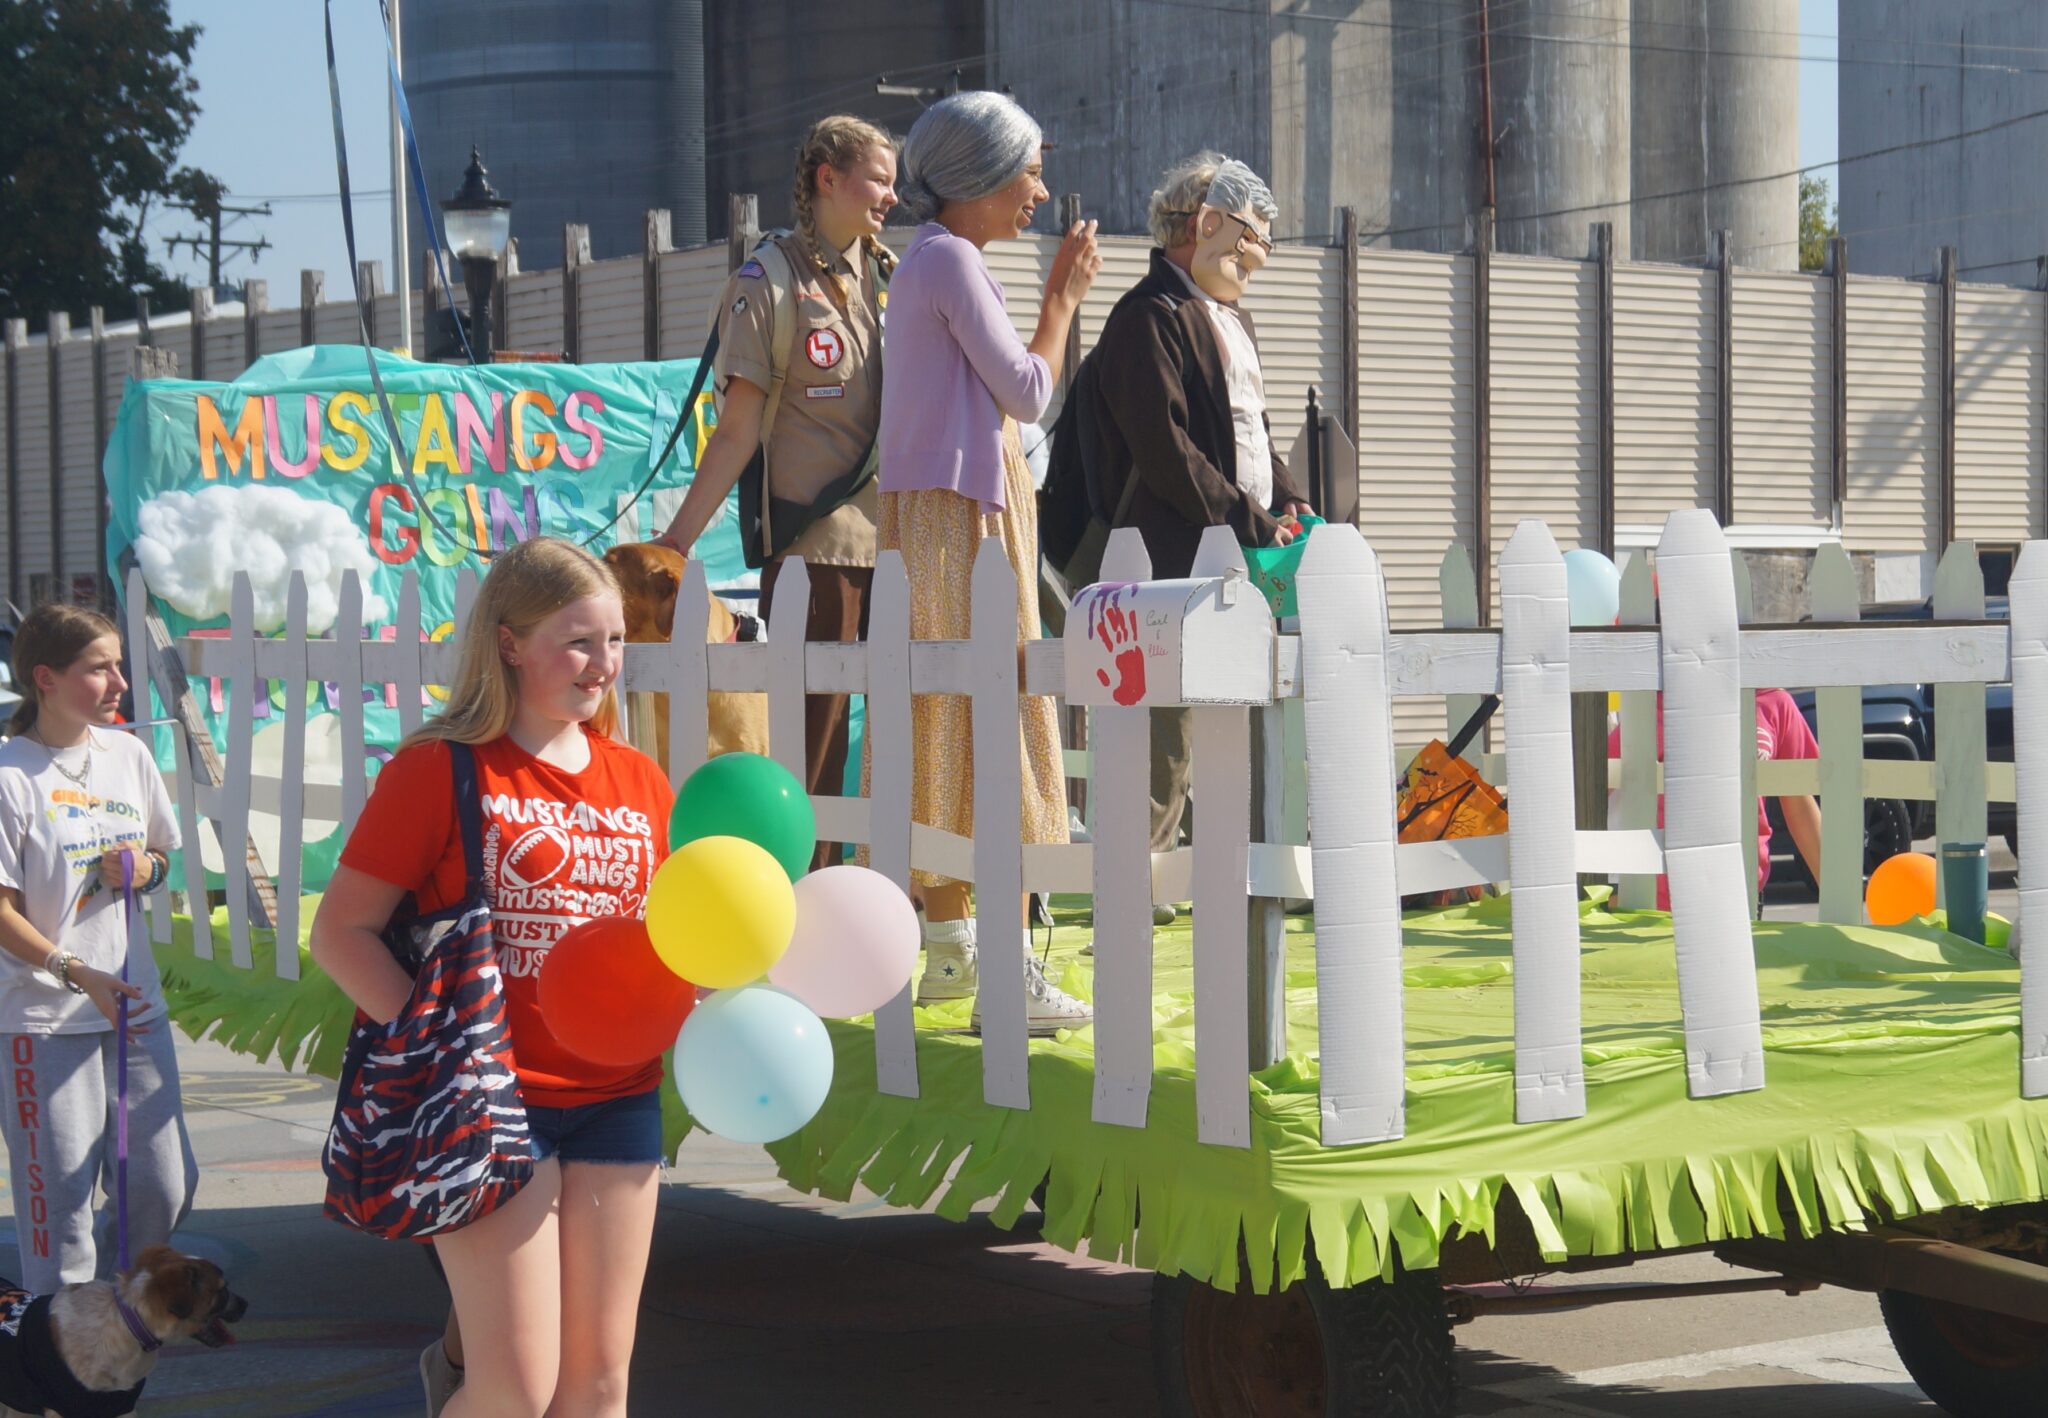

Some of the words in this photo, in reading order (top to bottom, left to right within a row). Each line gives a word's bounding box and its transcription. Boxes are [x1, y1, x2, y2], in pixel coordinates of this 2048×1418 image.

[196, 390, 606, 480] MUSTANGS
[481, 794, 652, 837] MUSTANGS
[572, 835, 642, 863] MUST
[568, 859, 640, 889] ANGS
[498, 883, 619, 917] mustangs
